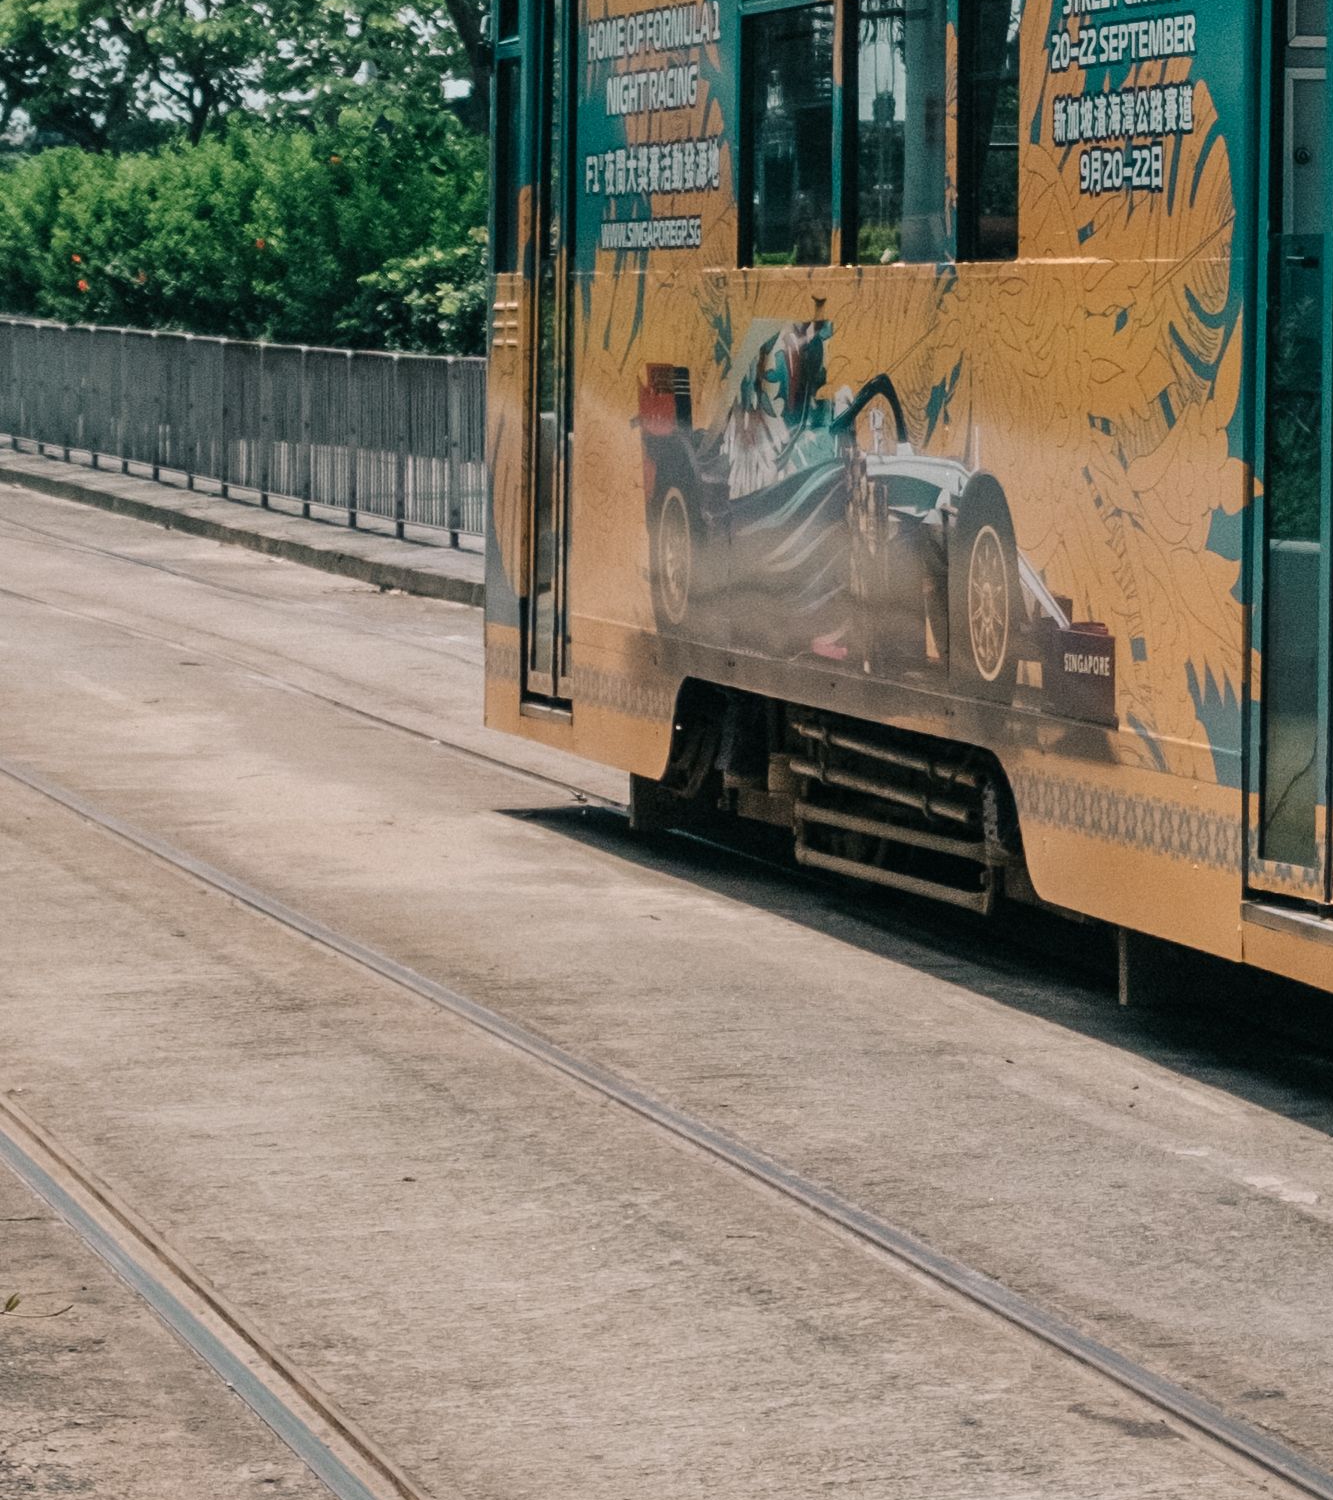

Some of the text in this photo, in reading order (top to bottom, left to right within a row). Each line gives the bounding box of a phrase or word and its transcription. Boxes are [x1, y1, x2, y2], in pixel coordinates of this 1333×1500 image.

[587, 0, 721, 64] HOME OF FORMULA 1
[1099, 13, 1196, 63] SEPTEMBER
[606, 63, 698, 116] NIGHT RACING
[600, 215, 702, 250] WWW.SINGAPOREGP.SG
[1063, 652, 1110, 677] SINGAPORE
